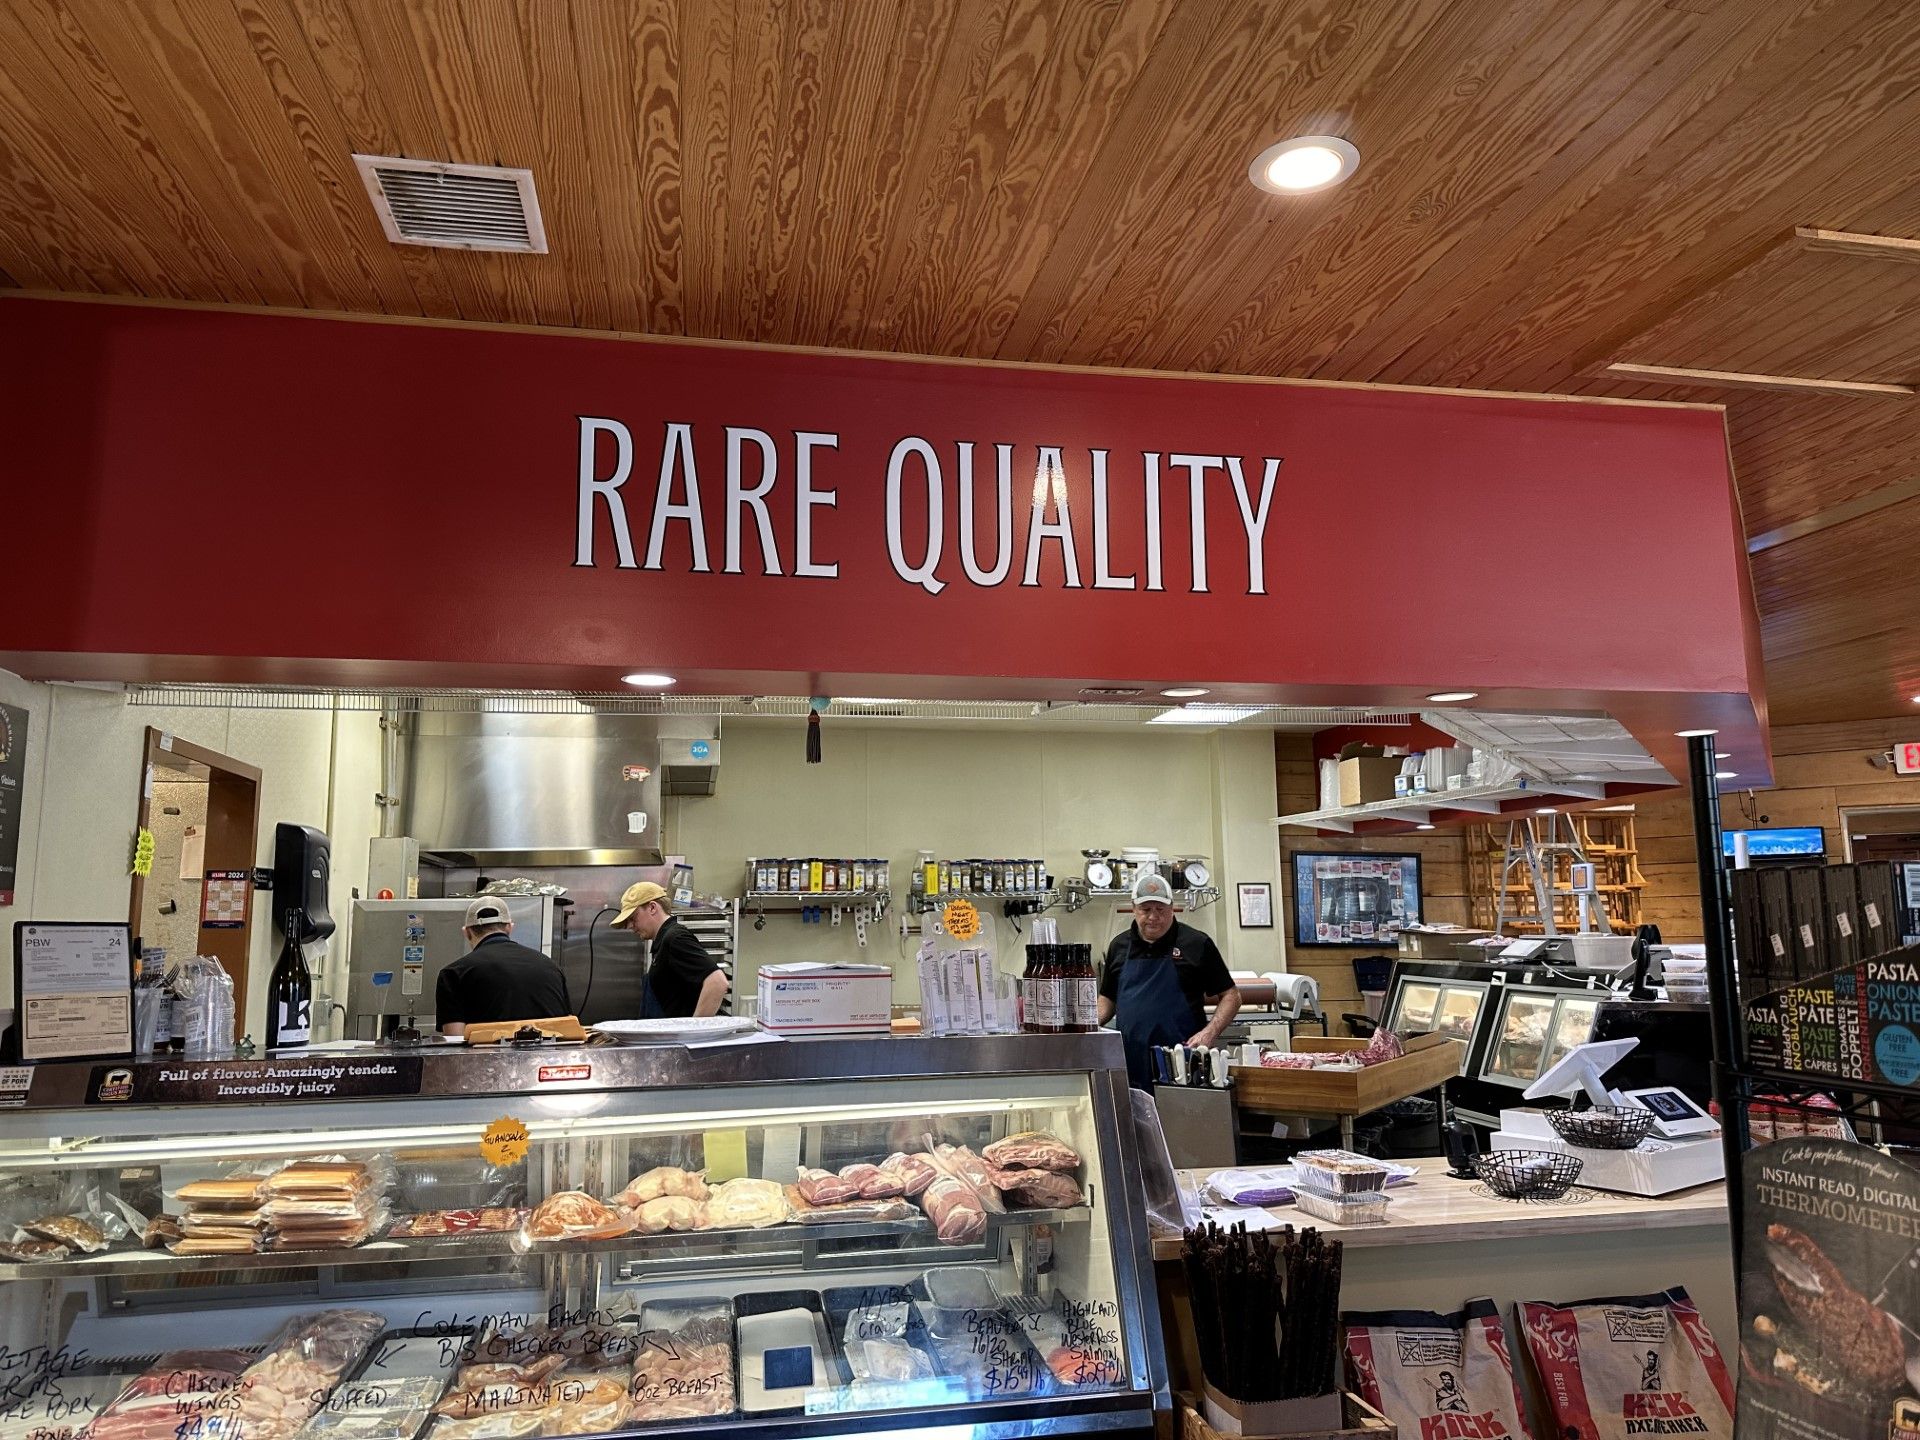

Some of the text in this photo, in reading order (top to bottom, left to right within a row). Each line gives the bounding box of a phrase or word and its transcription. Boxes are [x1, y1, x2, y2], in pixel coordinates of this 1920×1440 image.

[571, 415, 1284, 597] RARE QUALITY
[25, 938, 121, 947] PBW 24
[1867, 963, 1920, 982] PASTA
[1797, 988, 1834, 1005] PASTE
[1867, 983, 1920, 1001] ONION
[1741, 1005, 1778, 1024] PASTA
[1868, 1001, 1920, 1023] PASTE
[1749, 1024, 1778, 1037] APERS
[1781, 1014, 1793, 1070] CAPPERI
[1788, 989, 1802, 1071] KNOBLAUCH
[1802, 1025, 1836, 1042] PASTE
[1838, 1007, 1850, 1078] DE TOMATES
[1847, 1008, 1863, 1079] DOPPELT
[1889, 1043, 1907, 1053] FREE
[159, 1064, 397, 1081] Full of flavor. Amazingly tender.
[1891, 1068, 1909, 1078] FREE
[218, 1082, 336, 1096] Incredibly juicy.
[1762, 1166, 1920, 1212] INSTANT READ, DIGITAL
[412, 1306, 620, 1337] COLEMAN FARMS
[1066, 1319, 1097, 1335] BLUE
[487, 1332, 571, 1357] CHICKEN
[582, 1329, 655, 1353] BREAST
[972, 1335, 1008, 1362] 16/20
[166, 1370, 254, 1398] CHICKEN
[1553, 1371, 1569, 1409] BEST FOR:
[46, 1393, 95, 1421] PORK
[176, 1394, 242, 1415] WINGS
[463, 1380, 588, 1416] MARINATED
[1419, 1411, 1507, 1440] KICK
